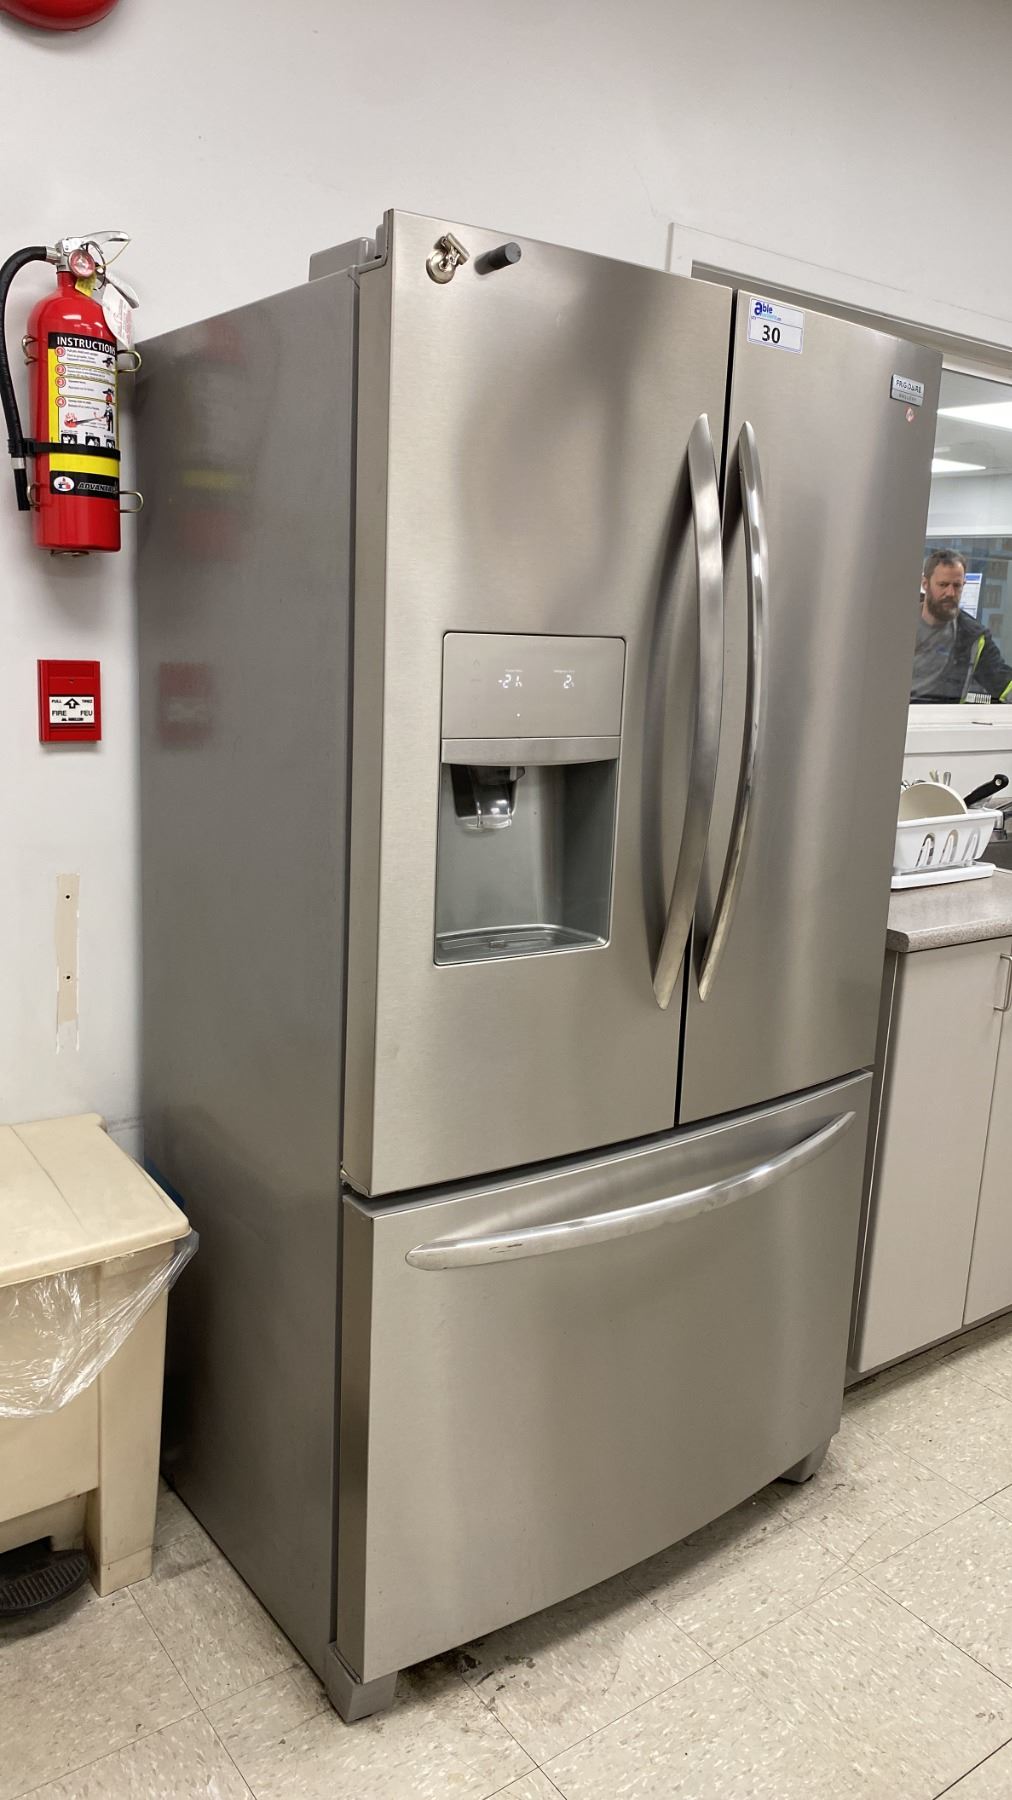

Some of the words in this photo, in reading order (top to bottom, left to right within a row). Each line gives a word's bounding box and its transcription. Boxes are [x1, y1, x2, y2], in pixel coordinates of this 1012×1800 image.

[754, 301, 773, 315] able
[762, 324, 780, 344] 30
[56, 336, 116, 357] INSTRUCTIONS
